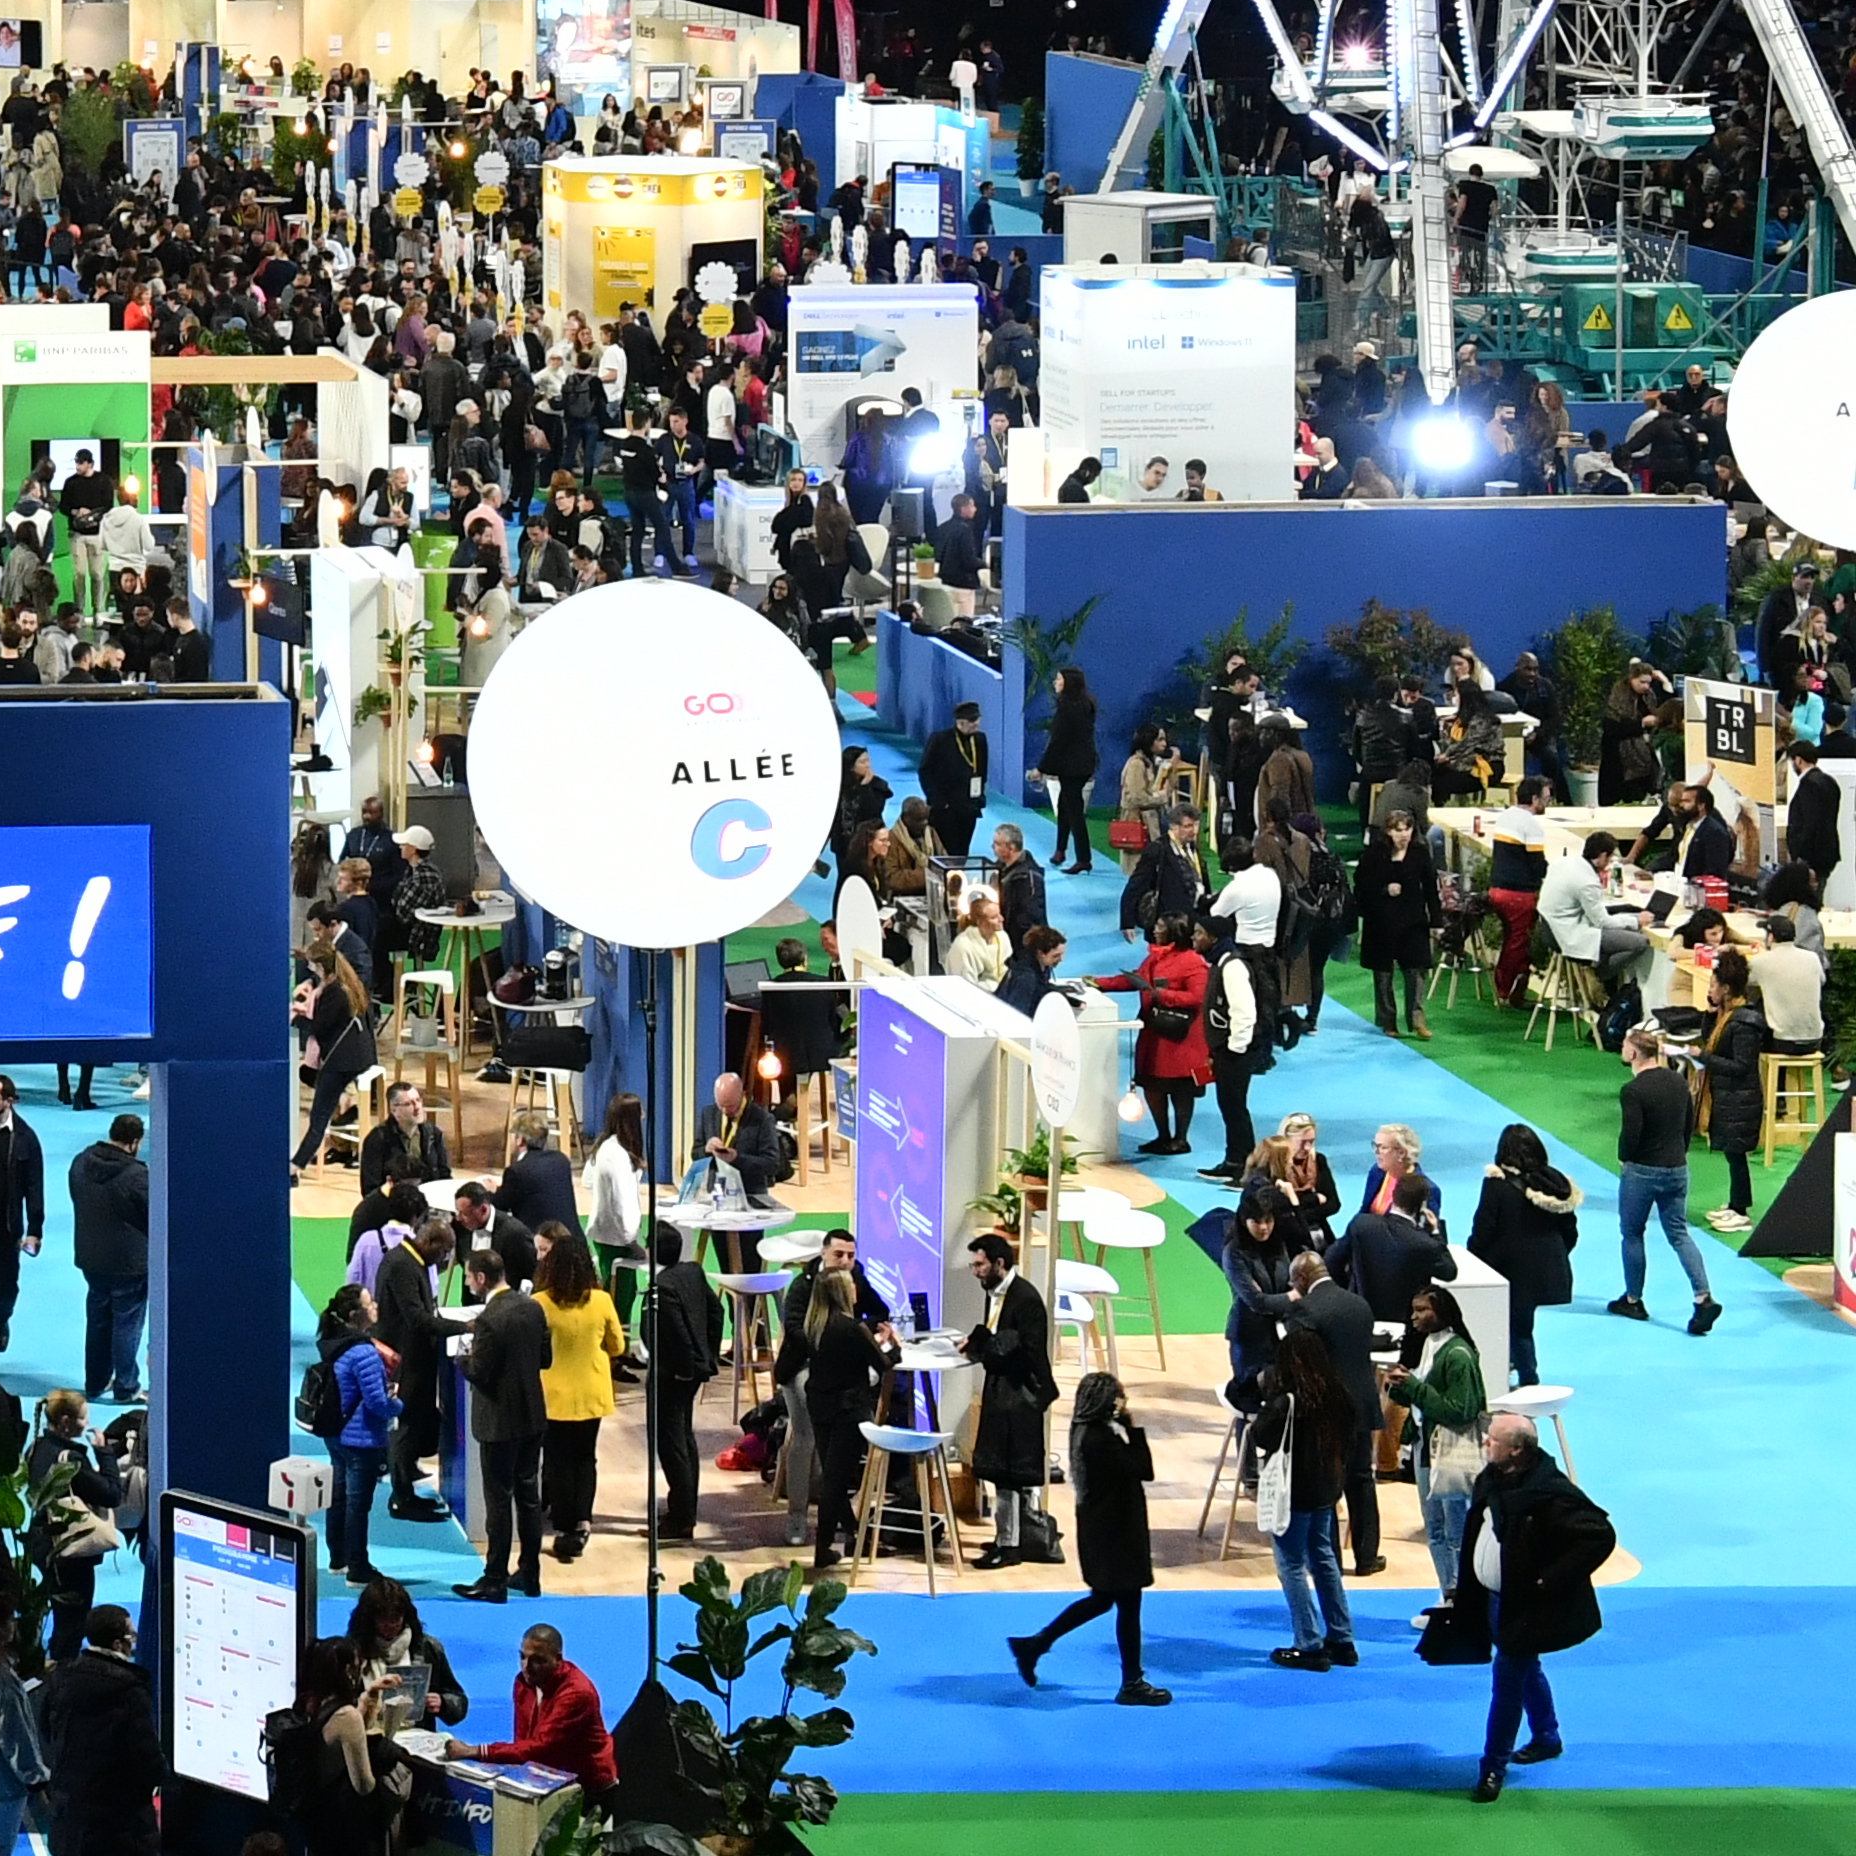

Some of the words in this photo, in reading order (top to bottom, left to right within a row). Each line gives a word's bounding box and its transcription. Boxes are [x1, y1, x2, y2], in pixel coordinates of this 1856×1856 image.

[1128, 334, 1166, 350] intel
[1197, 336, 1239, 347] Windows
[1717, 729, 1745, 754] BL
[671, 748, 795, 785] ALLÉE
[690, 798, 773, 880] C
[58, 874, 114, 994] !
